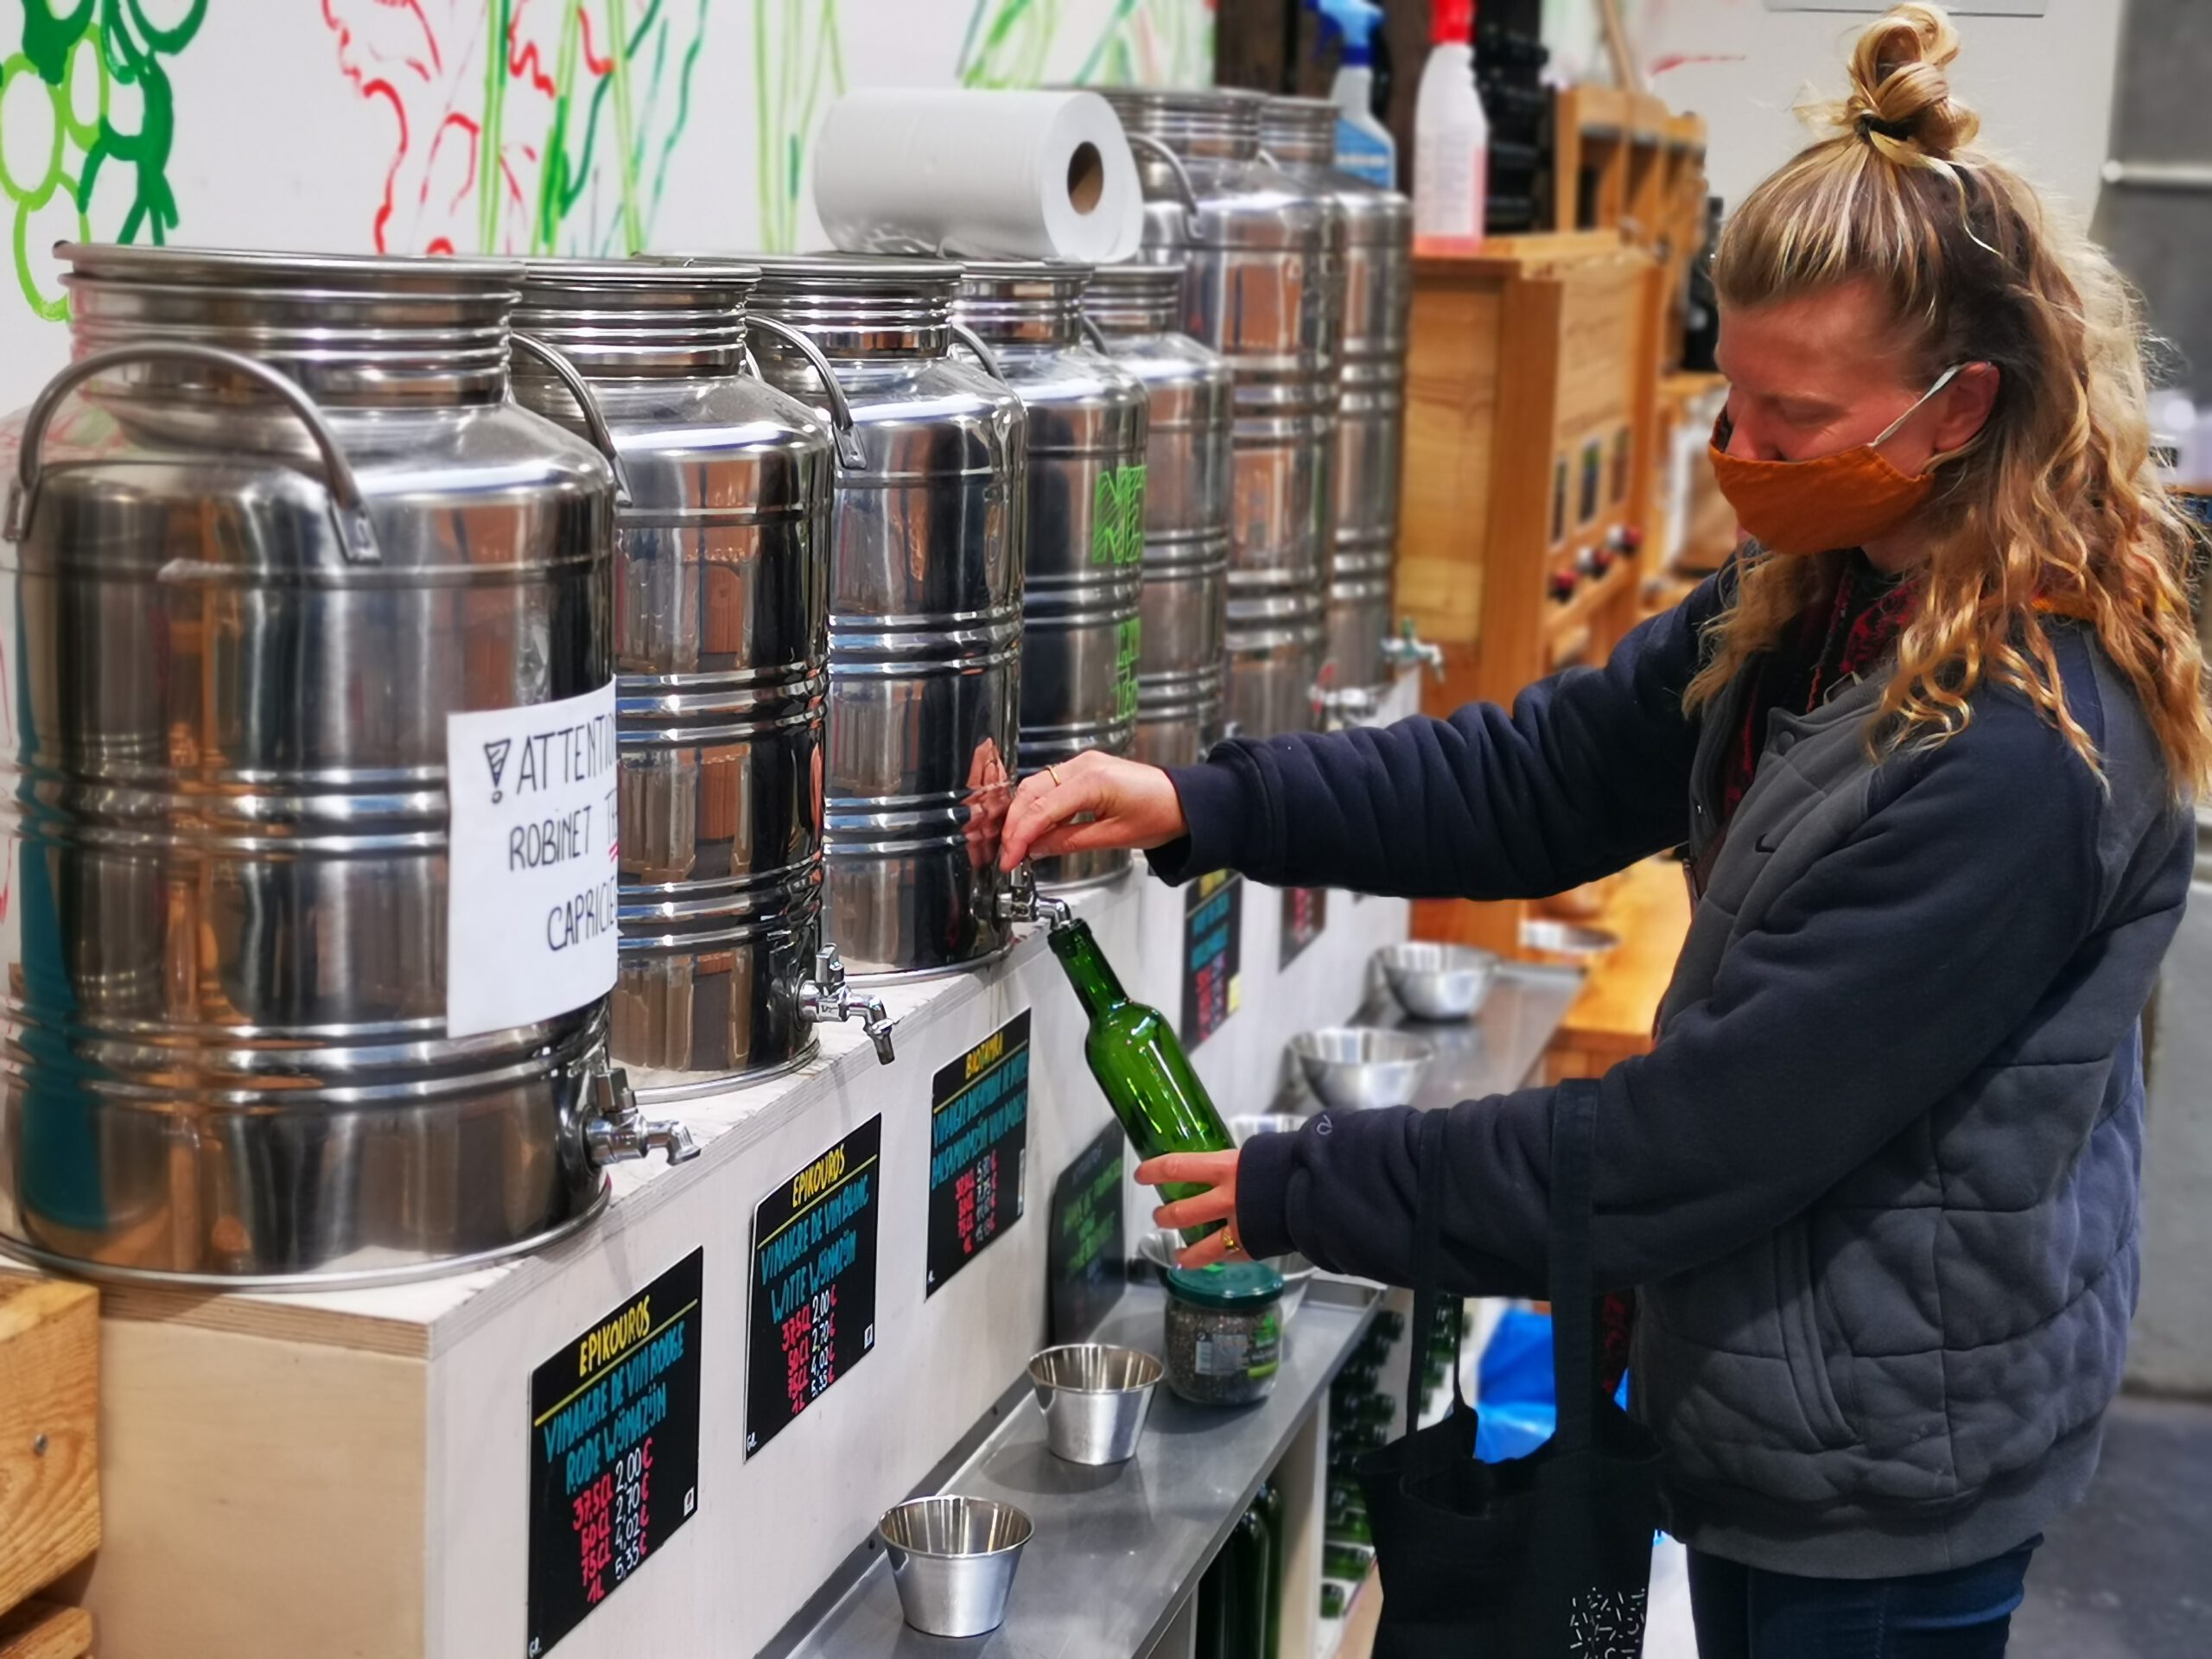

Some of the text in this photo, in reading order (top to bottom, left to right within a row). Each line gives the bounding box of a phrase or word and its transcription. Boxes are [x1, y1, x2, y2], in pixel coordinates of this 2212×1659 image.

[508, 804, 593, 872] ROBINET
[792, 1143, 846, 1208] EPIKOUROS
[580, 1294, 652, 1377] EPIKOUROS
[544, 1380, 608, 1464] VINAIGRE
[650, 1320, 685, 1381] ROUGE
[566, 1433, 601, 1492] RODE
